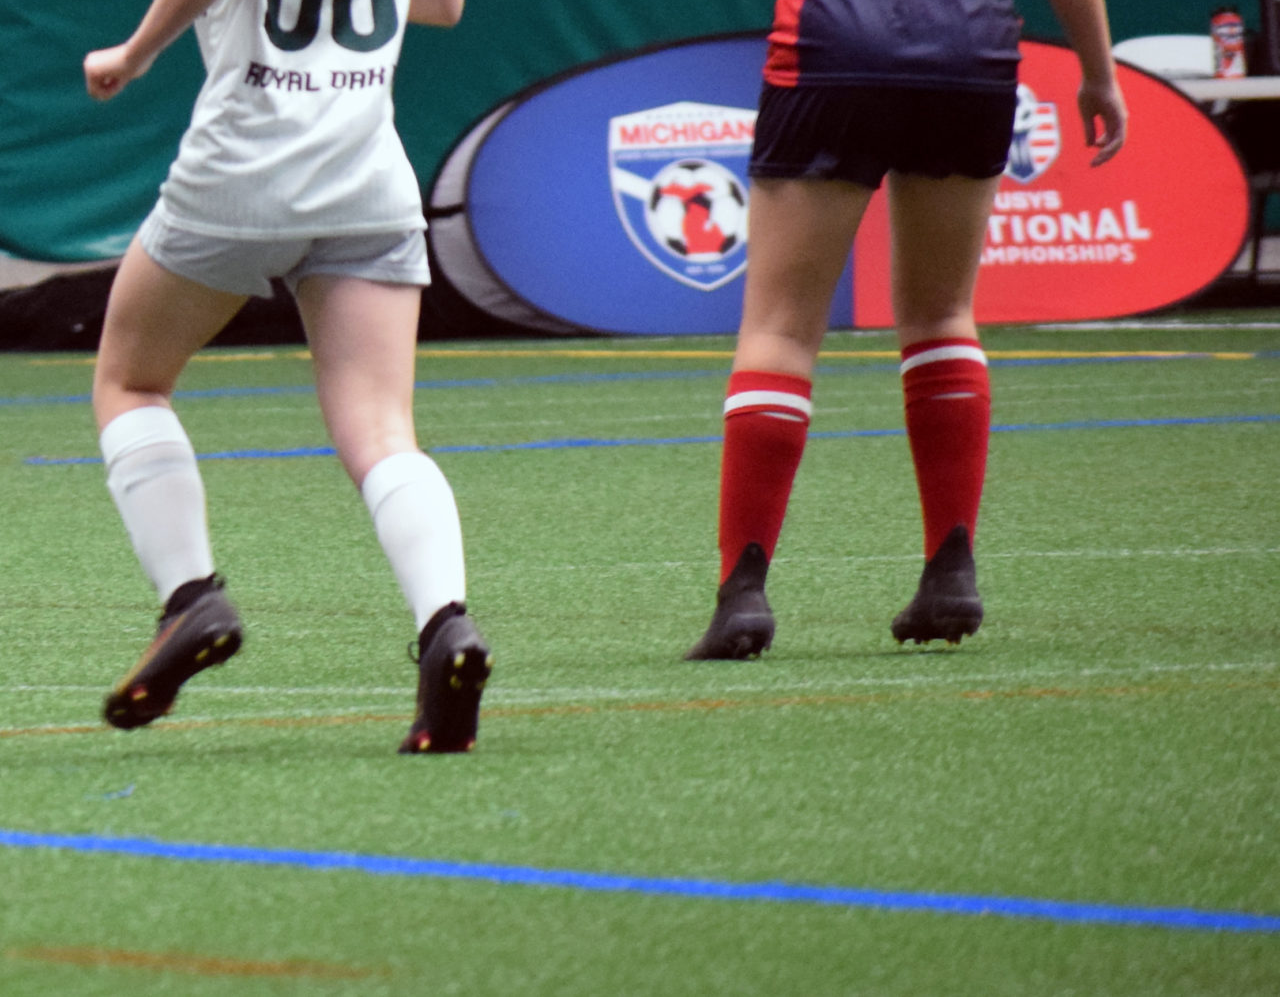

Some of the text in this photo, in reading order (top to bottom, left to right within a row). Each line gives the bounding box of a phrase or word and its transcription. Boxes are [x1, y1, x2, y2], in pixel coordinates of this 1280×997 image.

[244, 61, 320, 92] ROYAL
[620, 121, 756, 145] MICHIGAN
[988, 200, 1151, 243] TIONAL
[980, 243, 1136, 265] MPIONSHIPS
